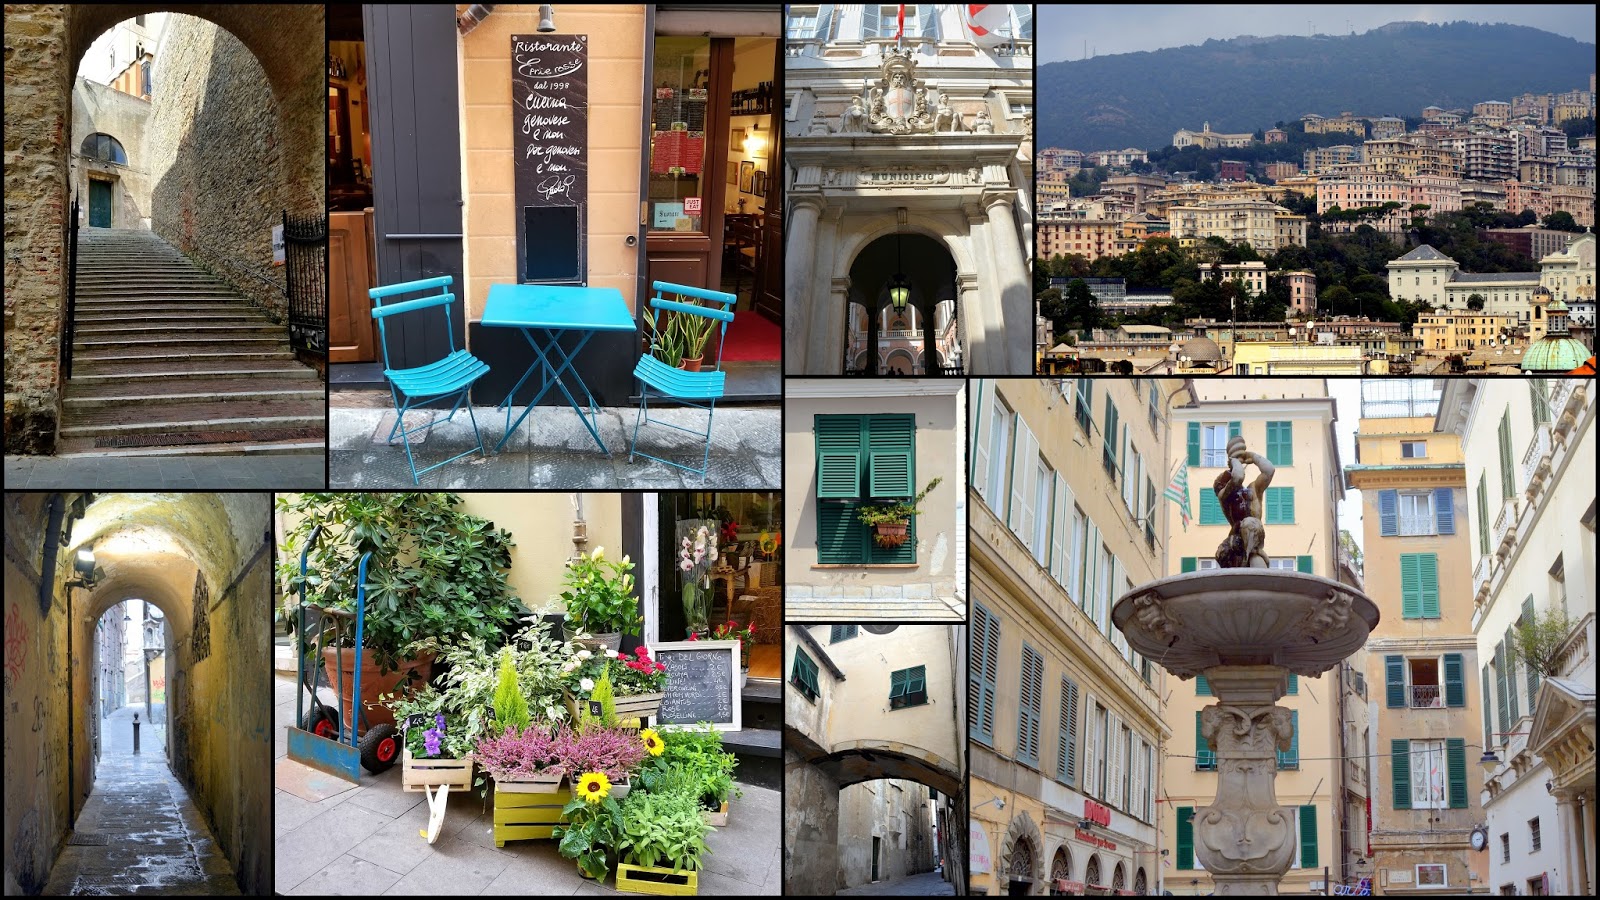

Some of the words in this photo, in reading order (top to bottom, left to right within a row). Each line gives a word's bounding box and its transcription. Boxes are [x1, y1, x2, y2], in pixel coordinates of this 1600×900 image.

[515, 41, 583, 53] Ristorante
[554, 58, 581, 73] rosse
[534, 81, 548, 90] dal
[550, 82, 570, 90] 1998
[525, 94, 567, 110] Cucina
[522, 114, 570, 134] genovese
[533, 128, 540, 141] e
[542, 129, 564, 139] non
[544, 144, 582, 164] genovesi
[536, 163, 543, 174] e
[871, 173, 934, 181] MUNICIPIO
